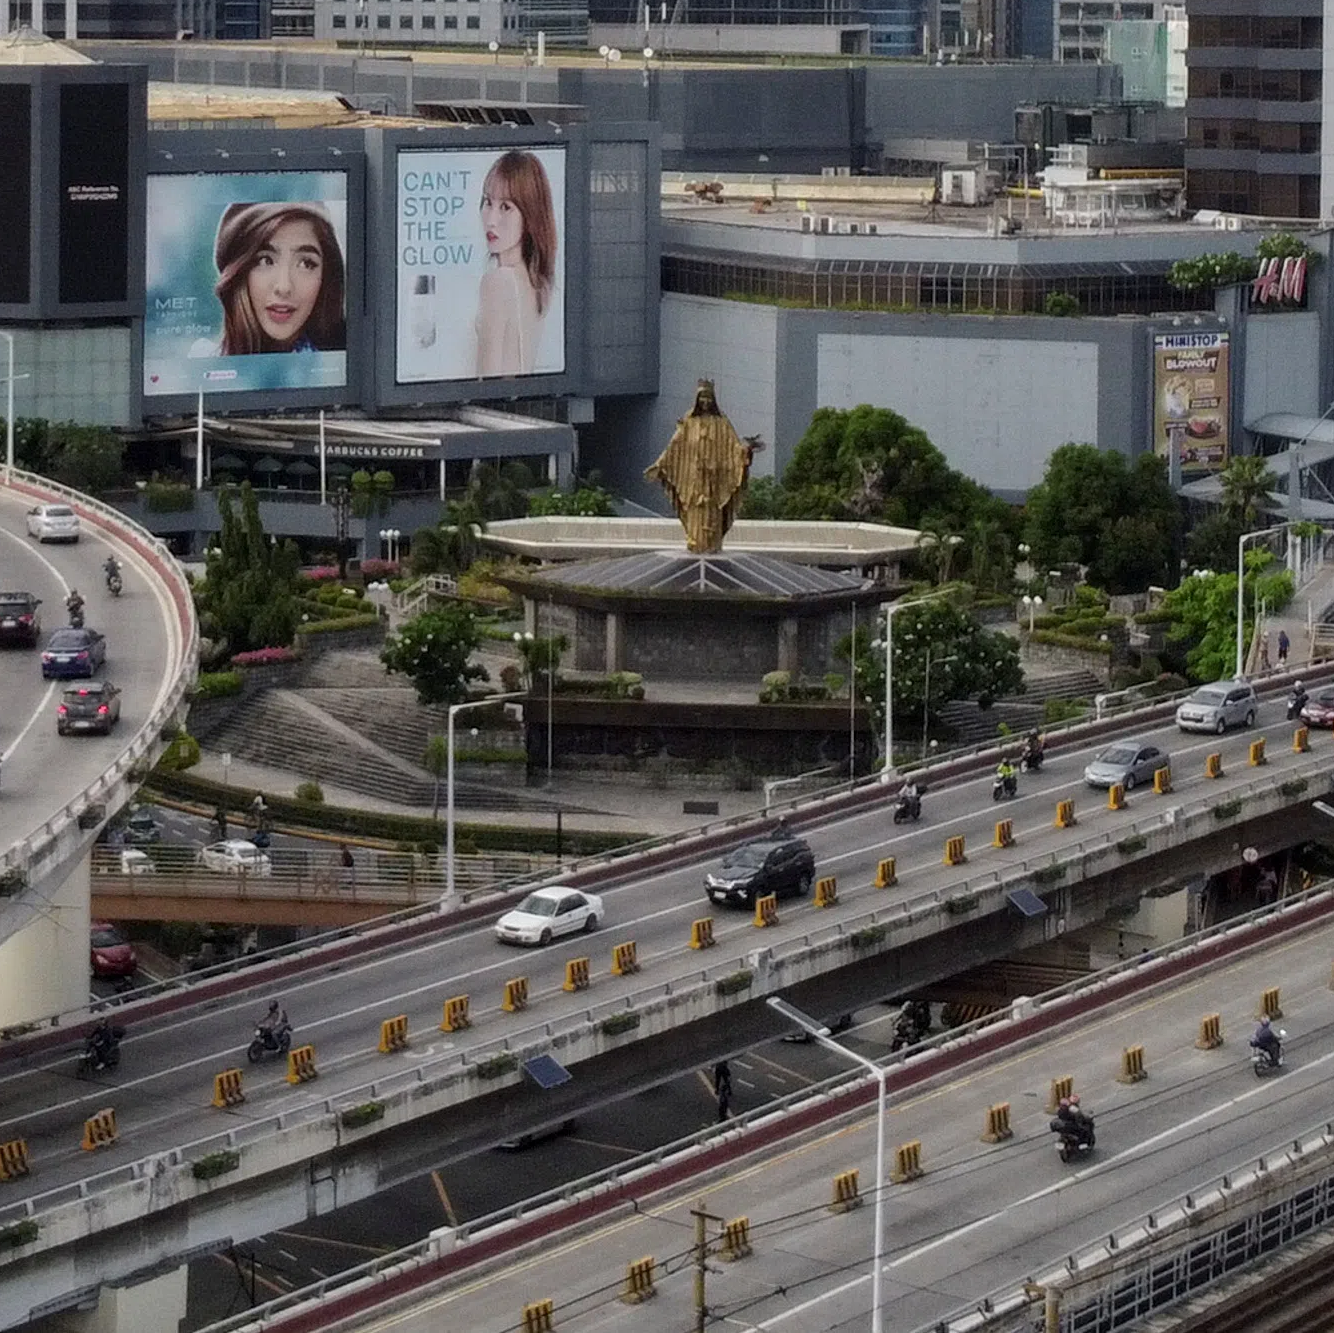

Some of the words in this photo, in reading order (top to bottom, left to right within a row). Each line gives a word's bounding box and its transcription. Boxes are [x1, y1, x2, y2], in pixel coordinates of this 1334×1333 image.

[404, 171, 471, 191] CAN'T
[403, 196, 465, 217] STOP
[403, 221, 446, 241] THE
[403, 244, 473, 266] GLOW
[1251, 256, 1307, 304] H&M
[155, 297, 197, 309] MET
[1166, 357, 1217, 370] BLOWOUT
[313, 445, 378, 456] SARBUCKS
[380, 447, 424, 457] COFFEE
